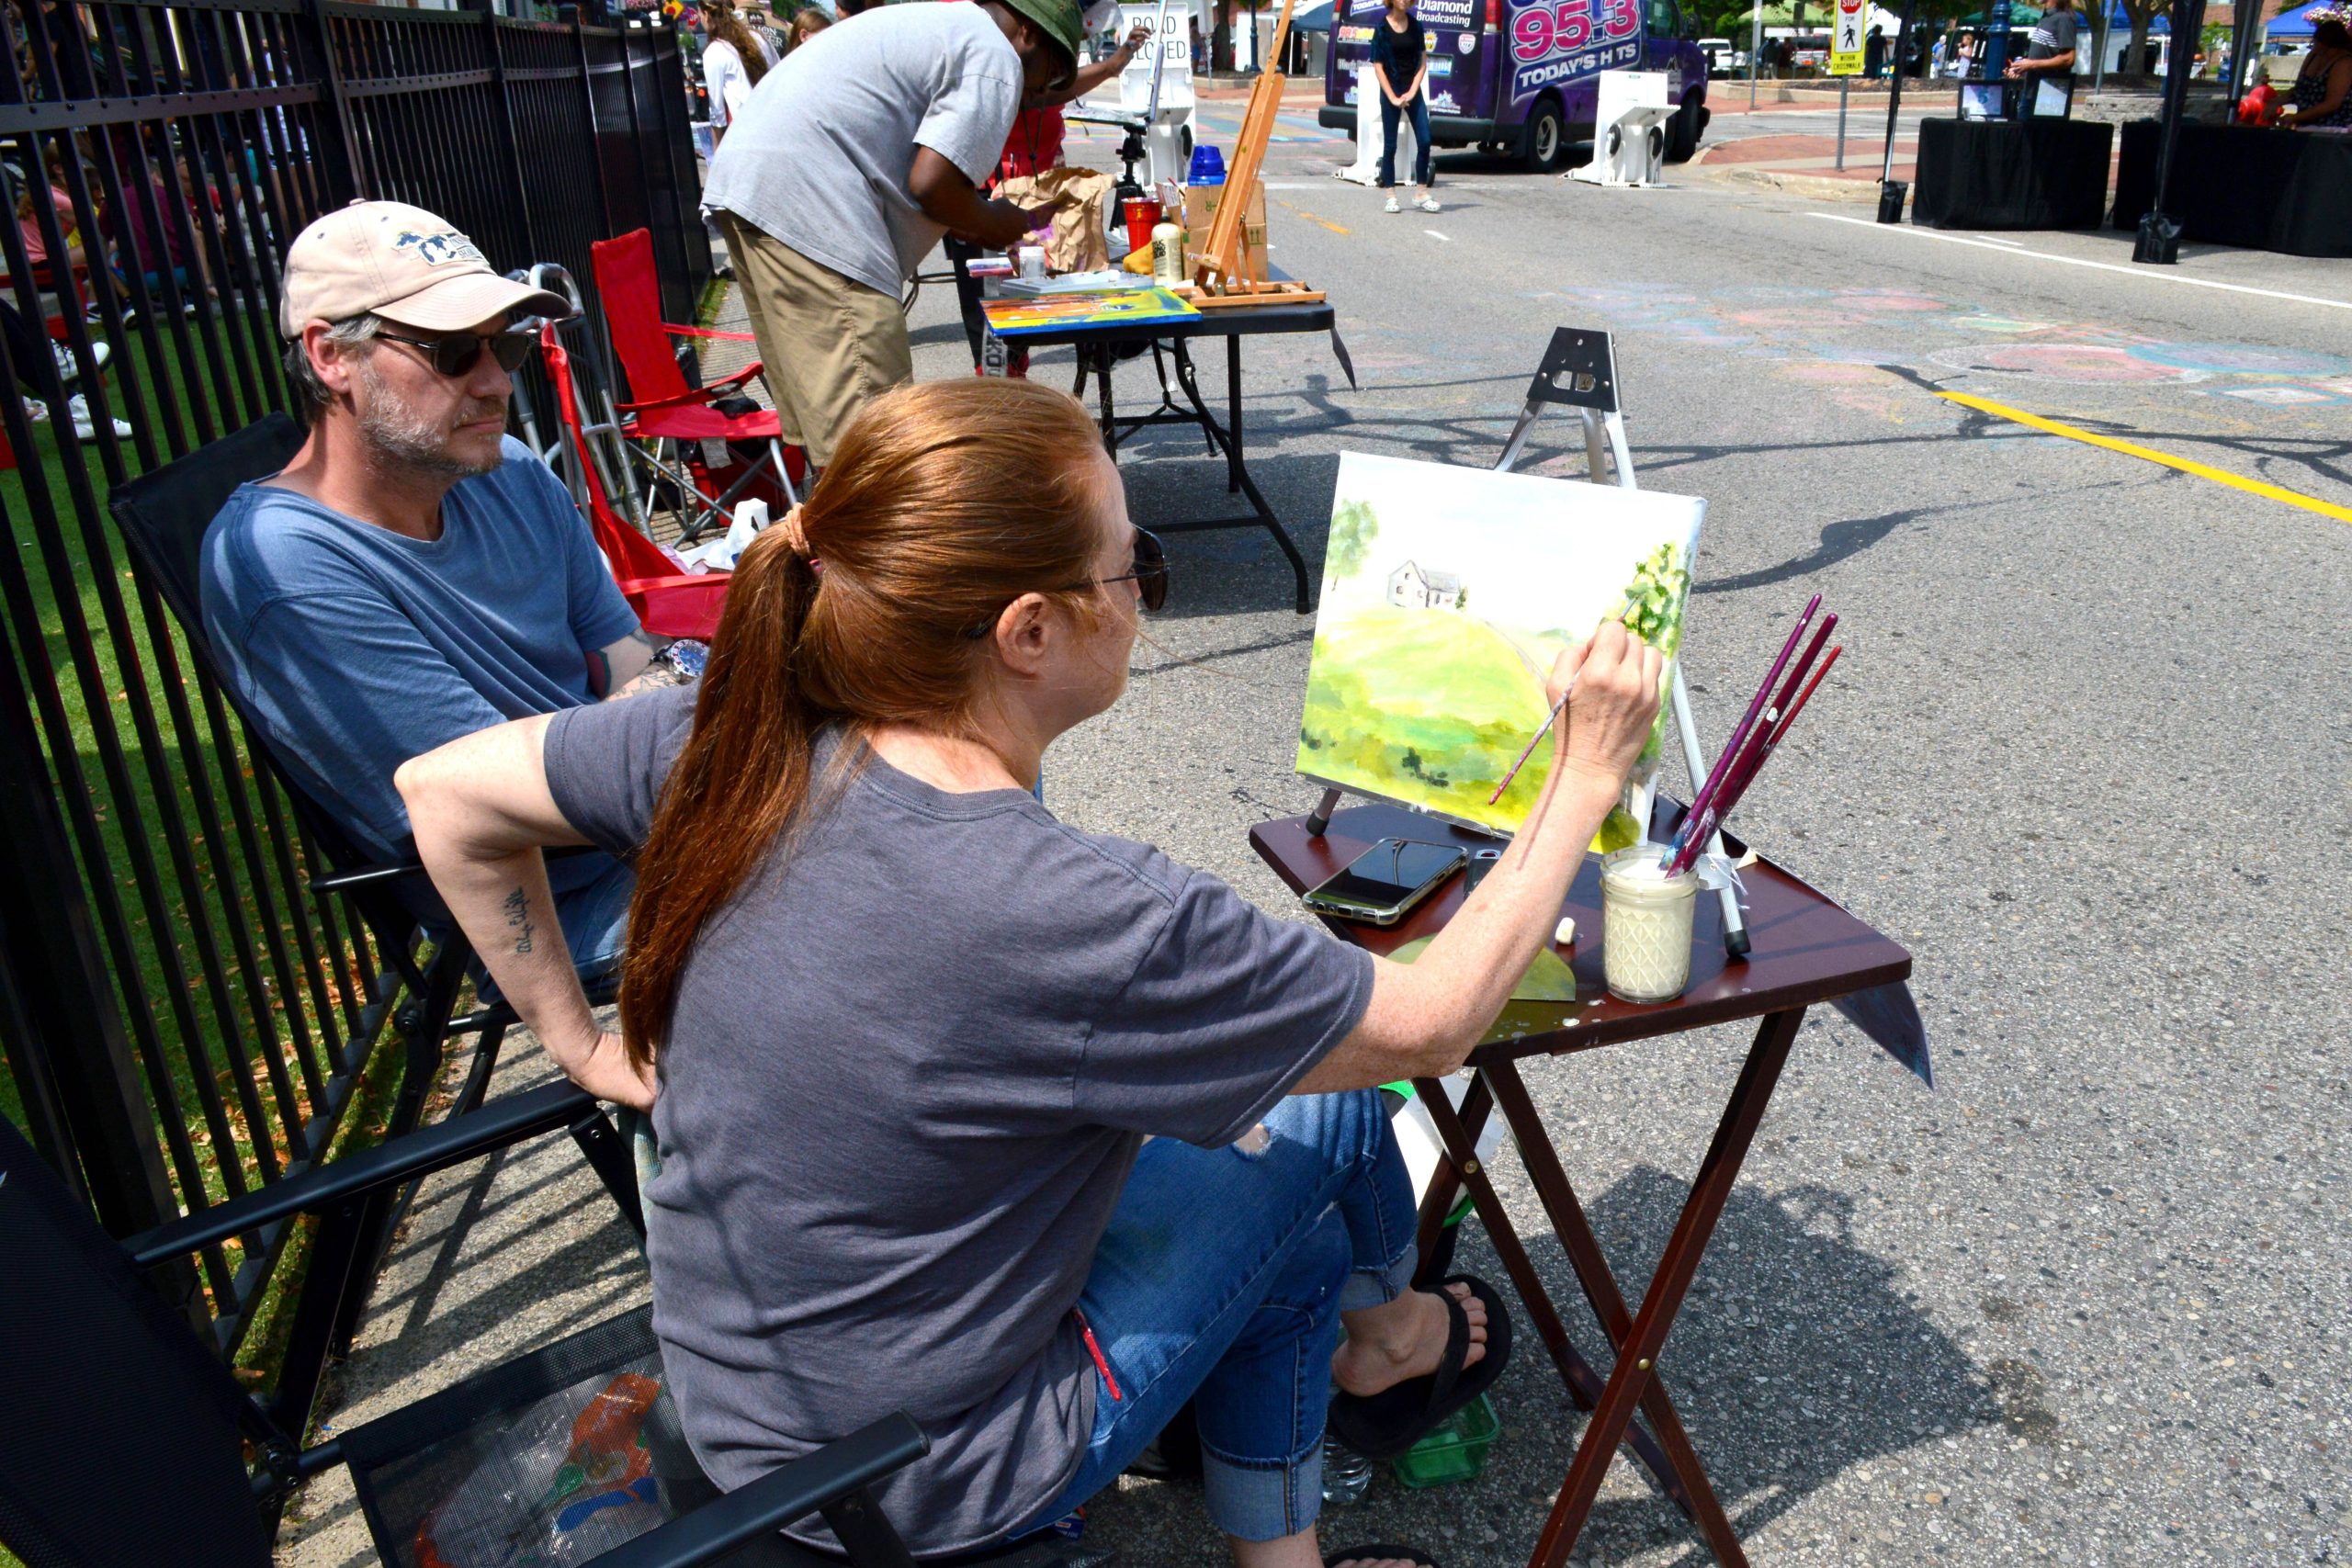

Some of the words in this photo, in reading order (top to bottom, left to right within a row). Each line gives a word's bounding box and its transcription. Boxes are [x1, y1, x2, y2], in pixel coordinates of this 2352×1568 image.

[1418, 0, 1473, 14] Diamond
[1133, 16, 1176, 35] ROD
[1416, 11, 1471, 28] Broadcasting
[1136, 40, 1186, 60] LOED
[1520, 53, 1596, 88] TODAY'S
